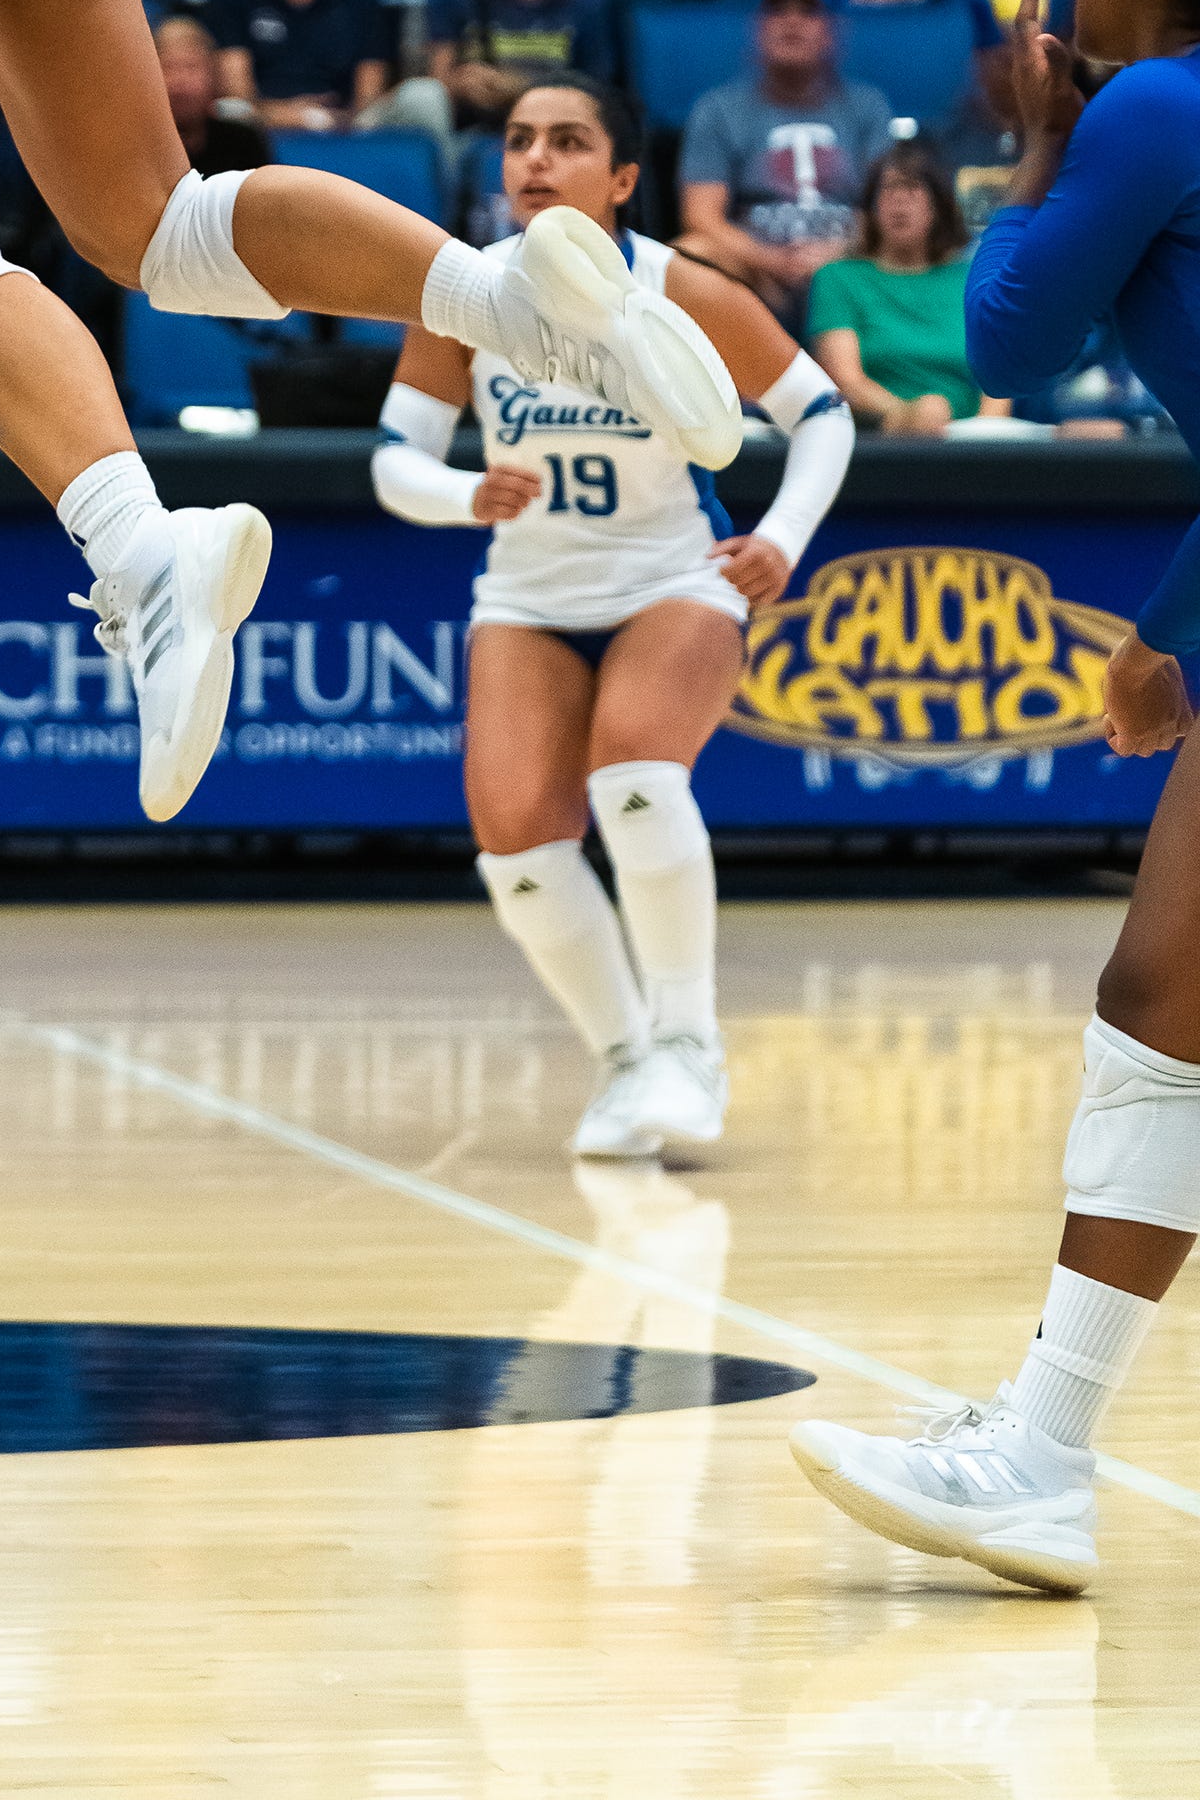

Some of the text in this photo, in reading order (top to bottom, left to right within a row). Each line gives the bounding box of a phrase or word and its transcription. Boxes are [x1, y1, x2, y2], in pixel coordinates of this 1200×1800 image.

[489, 375, 652, 446] Gauch
[543, 453, 620, 516] 19
[807, 555, 1057, 677] GAUCHO
[238, 620, 455, 718] FUN
